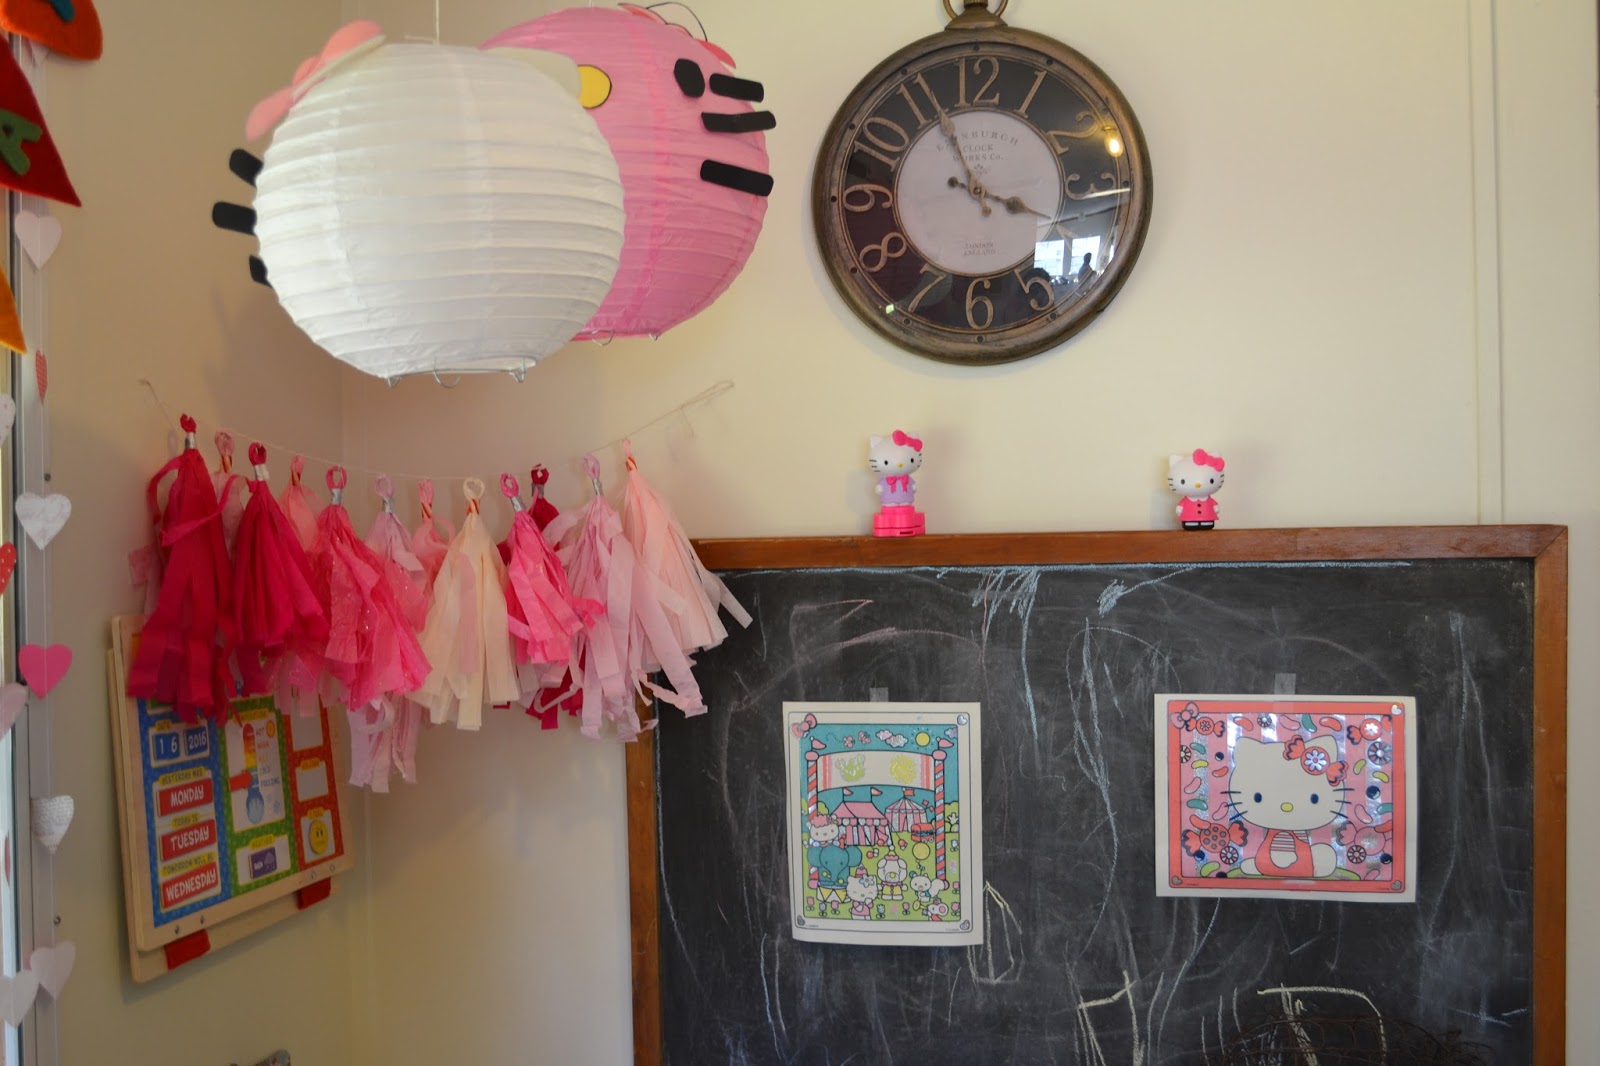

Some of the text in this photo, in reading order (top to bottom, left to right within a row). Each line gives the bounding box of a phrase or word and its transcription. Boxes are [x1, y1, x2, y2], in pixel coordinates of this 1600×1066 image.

[896, 71, 946, 131] 11
[954, 56, 1000, 108] 12
[1013, 69, 1048, 119] 1
[853, 116, 910, 173] 10
[1046, 110, 1099, 156] 2
[842, 182, 893, 214] 9
[1065, 172, 1116, 201] 3
[859, 231, 908, 273] 8
[907, 263, 948, 313] 7
[965, 278, 994, 330] 6
[1014, 264, 1056, 312] 5
[188, 731, 207, 750] 2016
[170, 784, 204, 807] MONDAY
[170, 825, 209, 852] TUESDAY
[166, 869, 217, 902] WEDNESDAY
